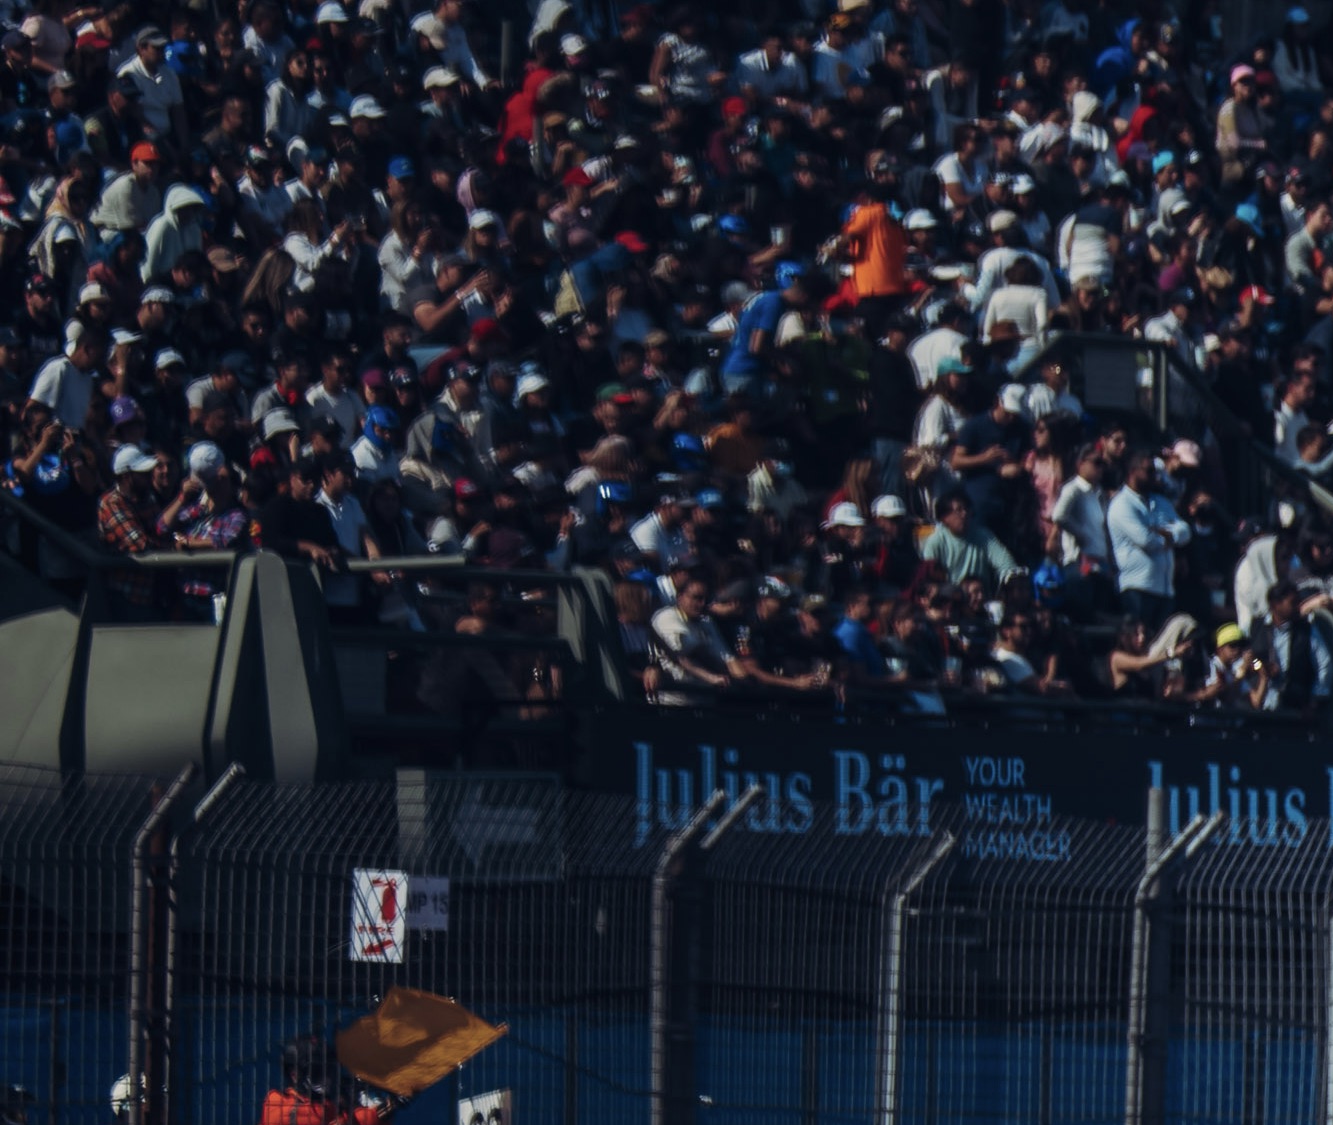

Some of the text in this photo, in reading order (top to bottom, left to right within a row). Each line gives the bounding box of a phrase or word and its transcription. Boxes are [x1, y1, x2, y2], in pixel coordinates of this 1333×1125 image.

[633, 741, 944, 849] Julius Bär
[966, 756, 1025, 787] YOUR
[966, 793, 1051, 823] WEALTH
[1147, 761, 1306, 849] ulius
